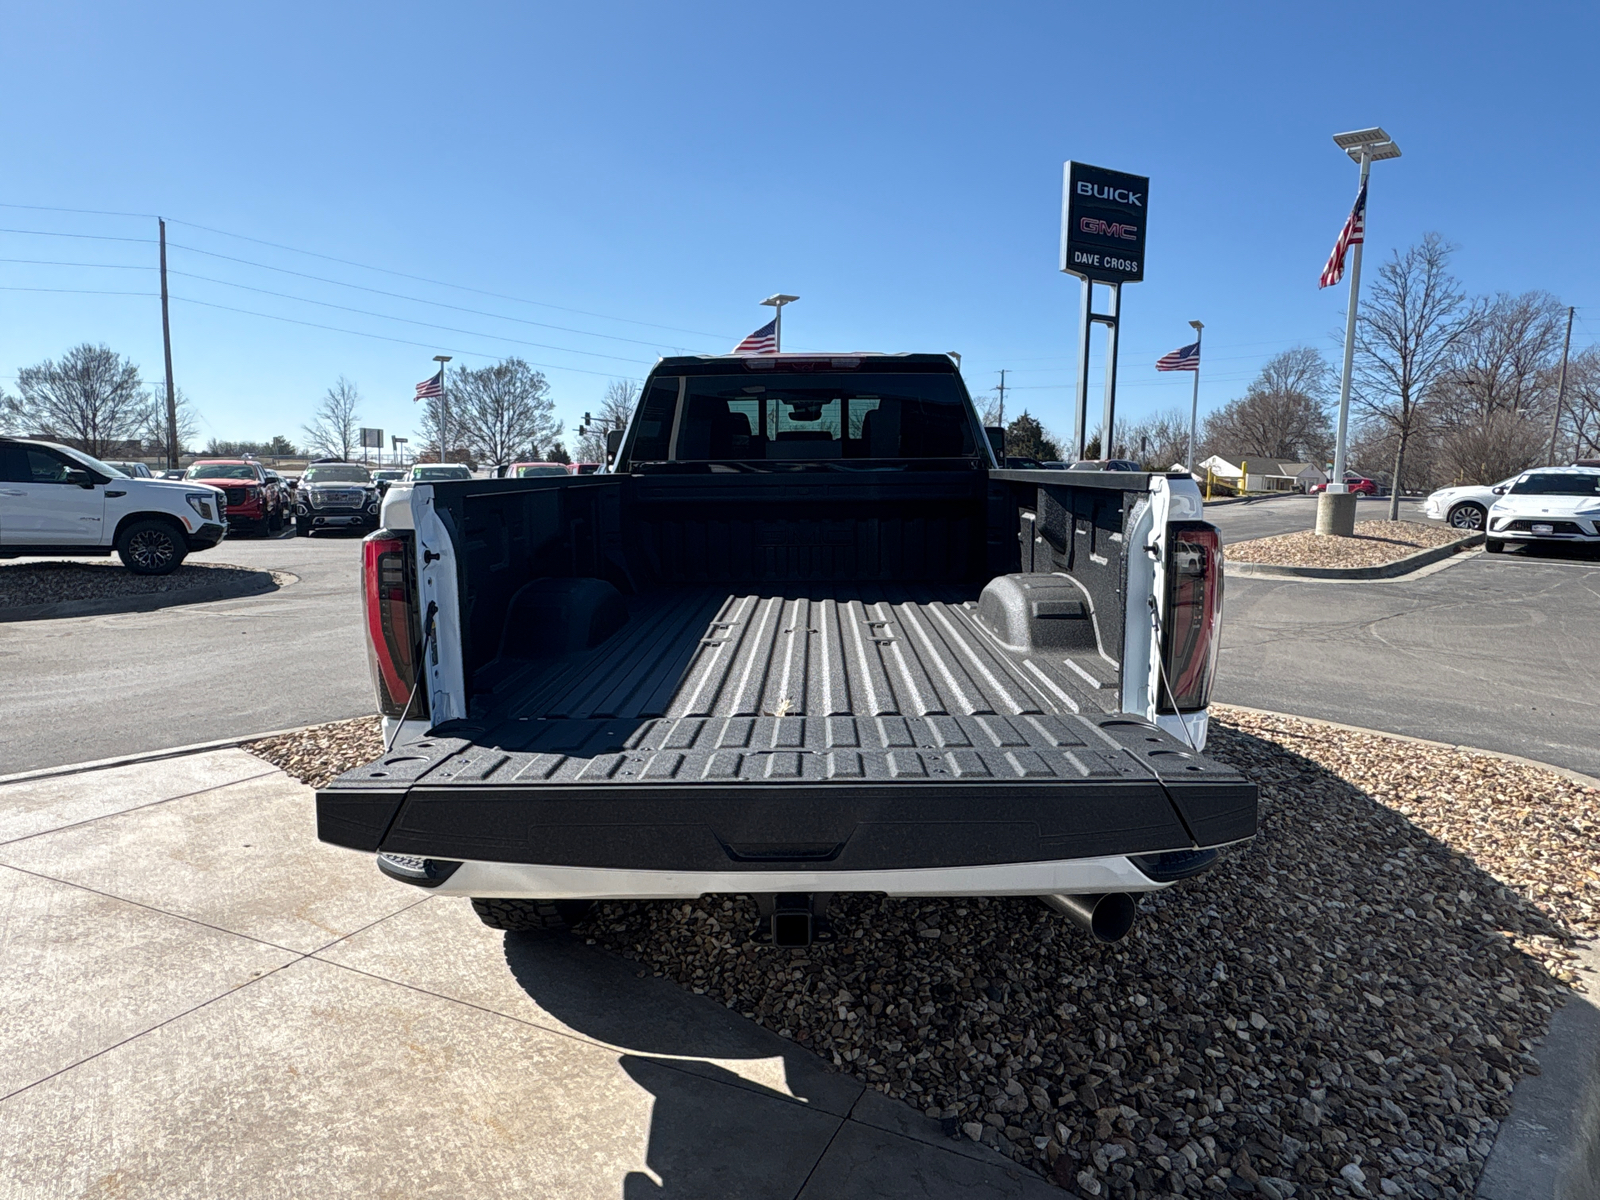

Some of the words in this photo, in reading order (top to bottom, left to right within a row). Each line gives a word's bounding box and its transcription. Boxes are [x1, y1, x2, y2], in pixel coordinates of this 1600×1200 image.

[1077, 181, 1142, 207] BUICK
[1080, 217, 1138, 240] GMC
[1074, 251, 1100, 266] DAVE
[1104, 256, 1138, 273] CROSS
